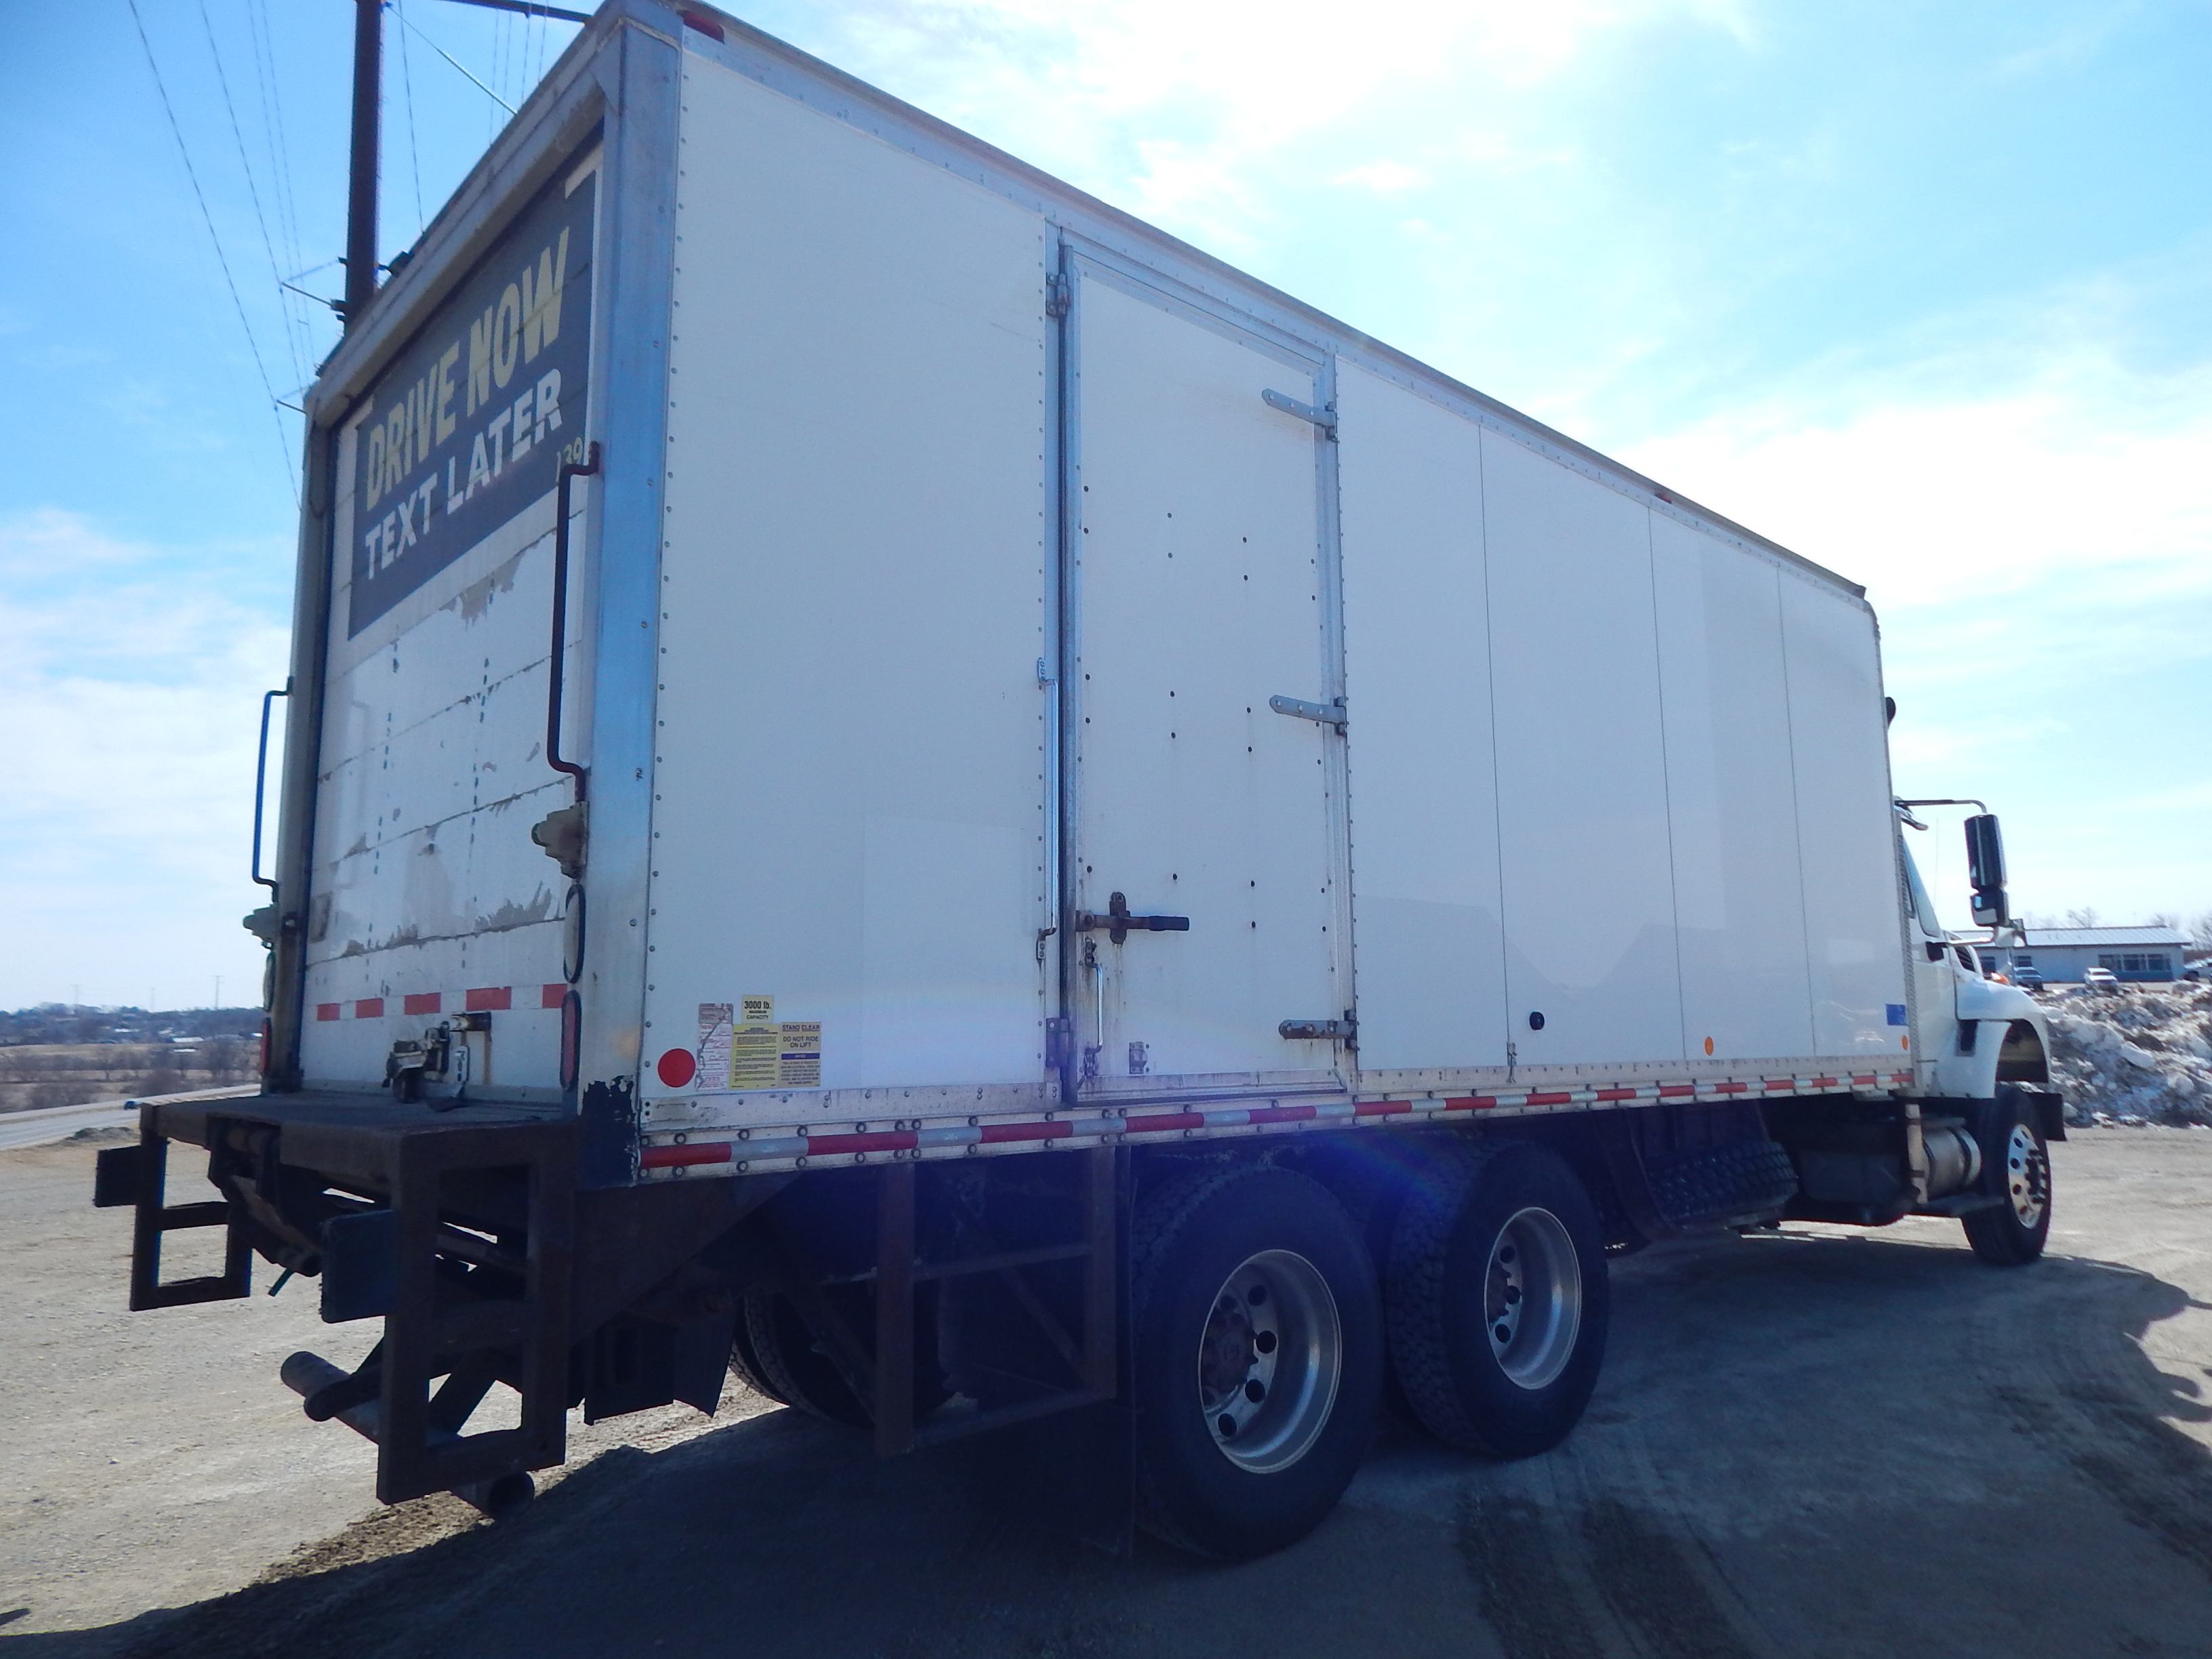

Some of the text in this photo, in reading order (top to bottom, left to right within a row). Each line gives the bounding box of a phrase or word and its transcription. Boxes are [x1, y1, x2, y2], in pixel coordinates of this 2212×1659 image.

[365, 368, 562, 580] TEXT LATER
[367, 226, 569, 511] DRIVE NOW
[744, 1000, 762, 1009] 3000
